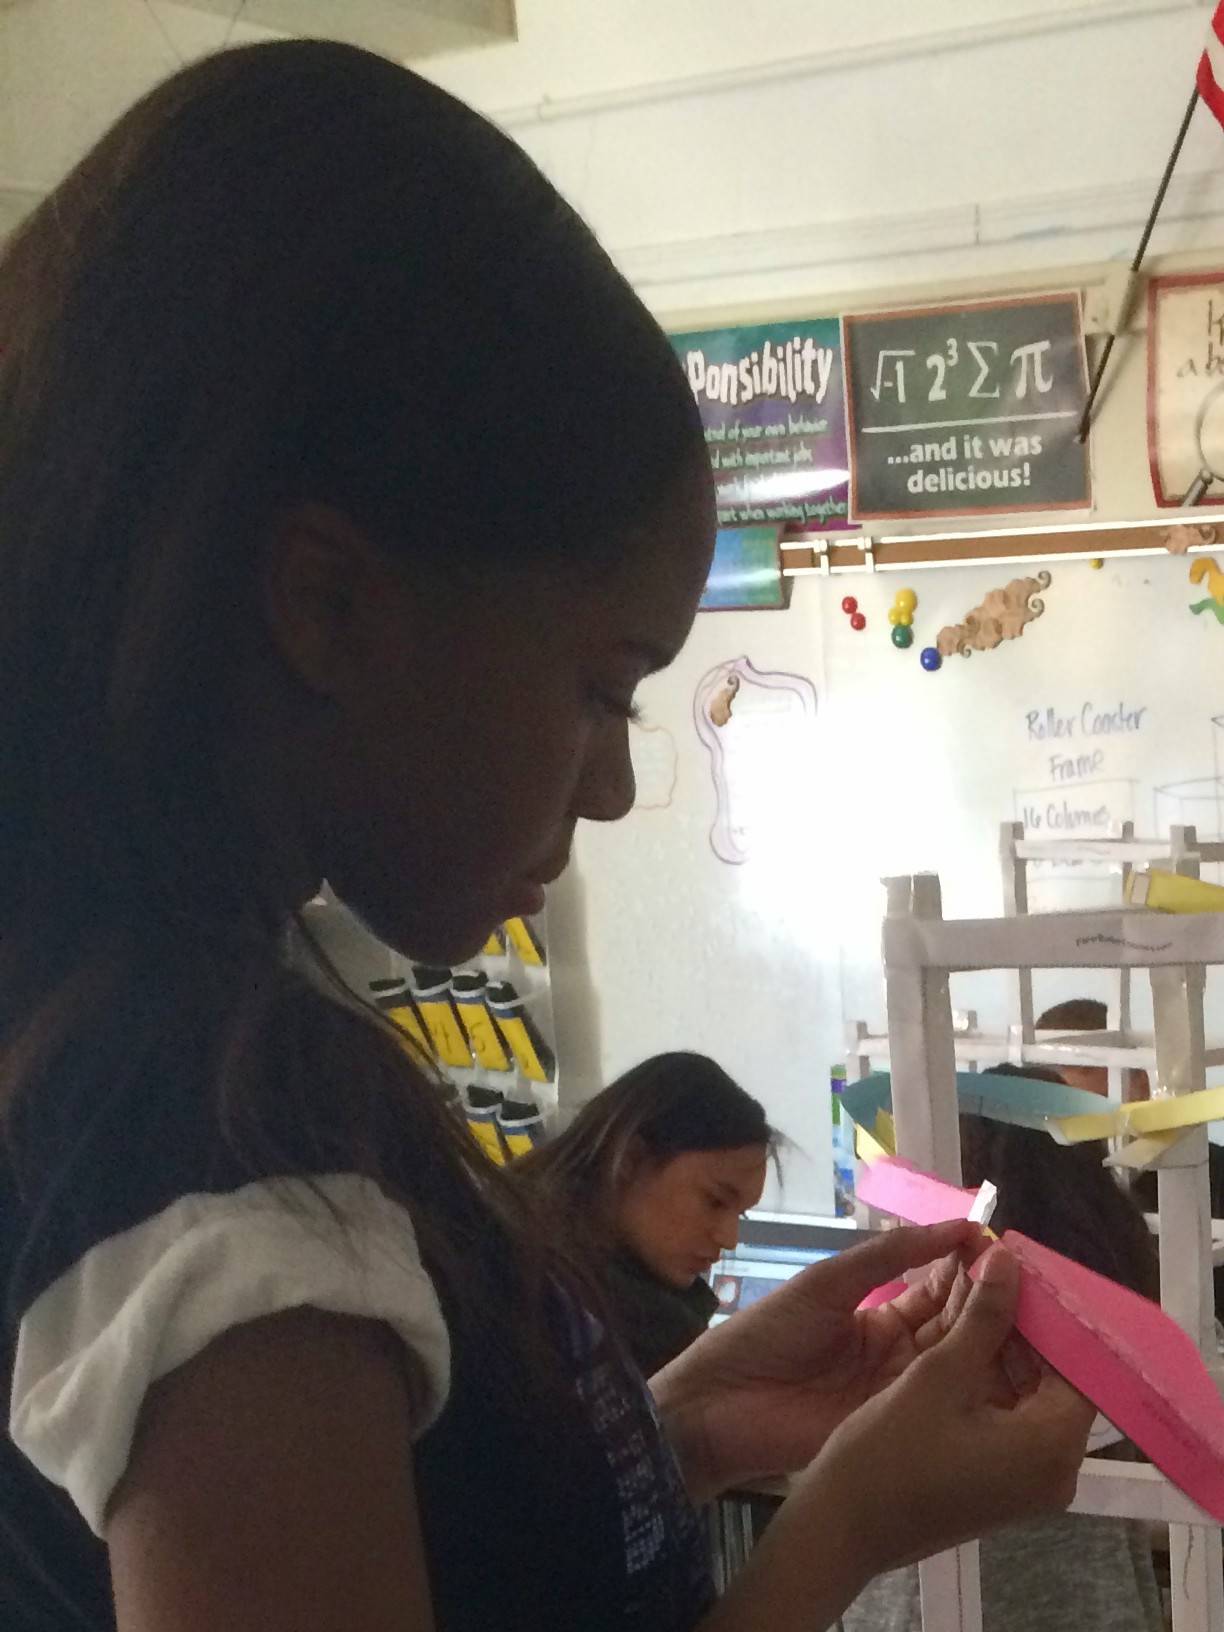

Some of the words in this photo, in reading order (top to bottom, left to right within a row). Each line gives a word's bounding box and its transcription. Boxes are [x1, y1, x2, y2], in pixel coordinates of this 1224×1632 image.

[687, 336, 834, 406] ponsibility
[963, 434, 983, 459] it
[989, 435, 1043, 456] was
[907, 462, 1031, 494] delicious!
[1025, 708, 1077, 740] Roller
[1049, 748, 1105, 781] Frame
